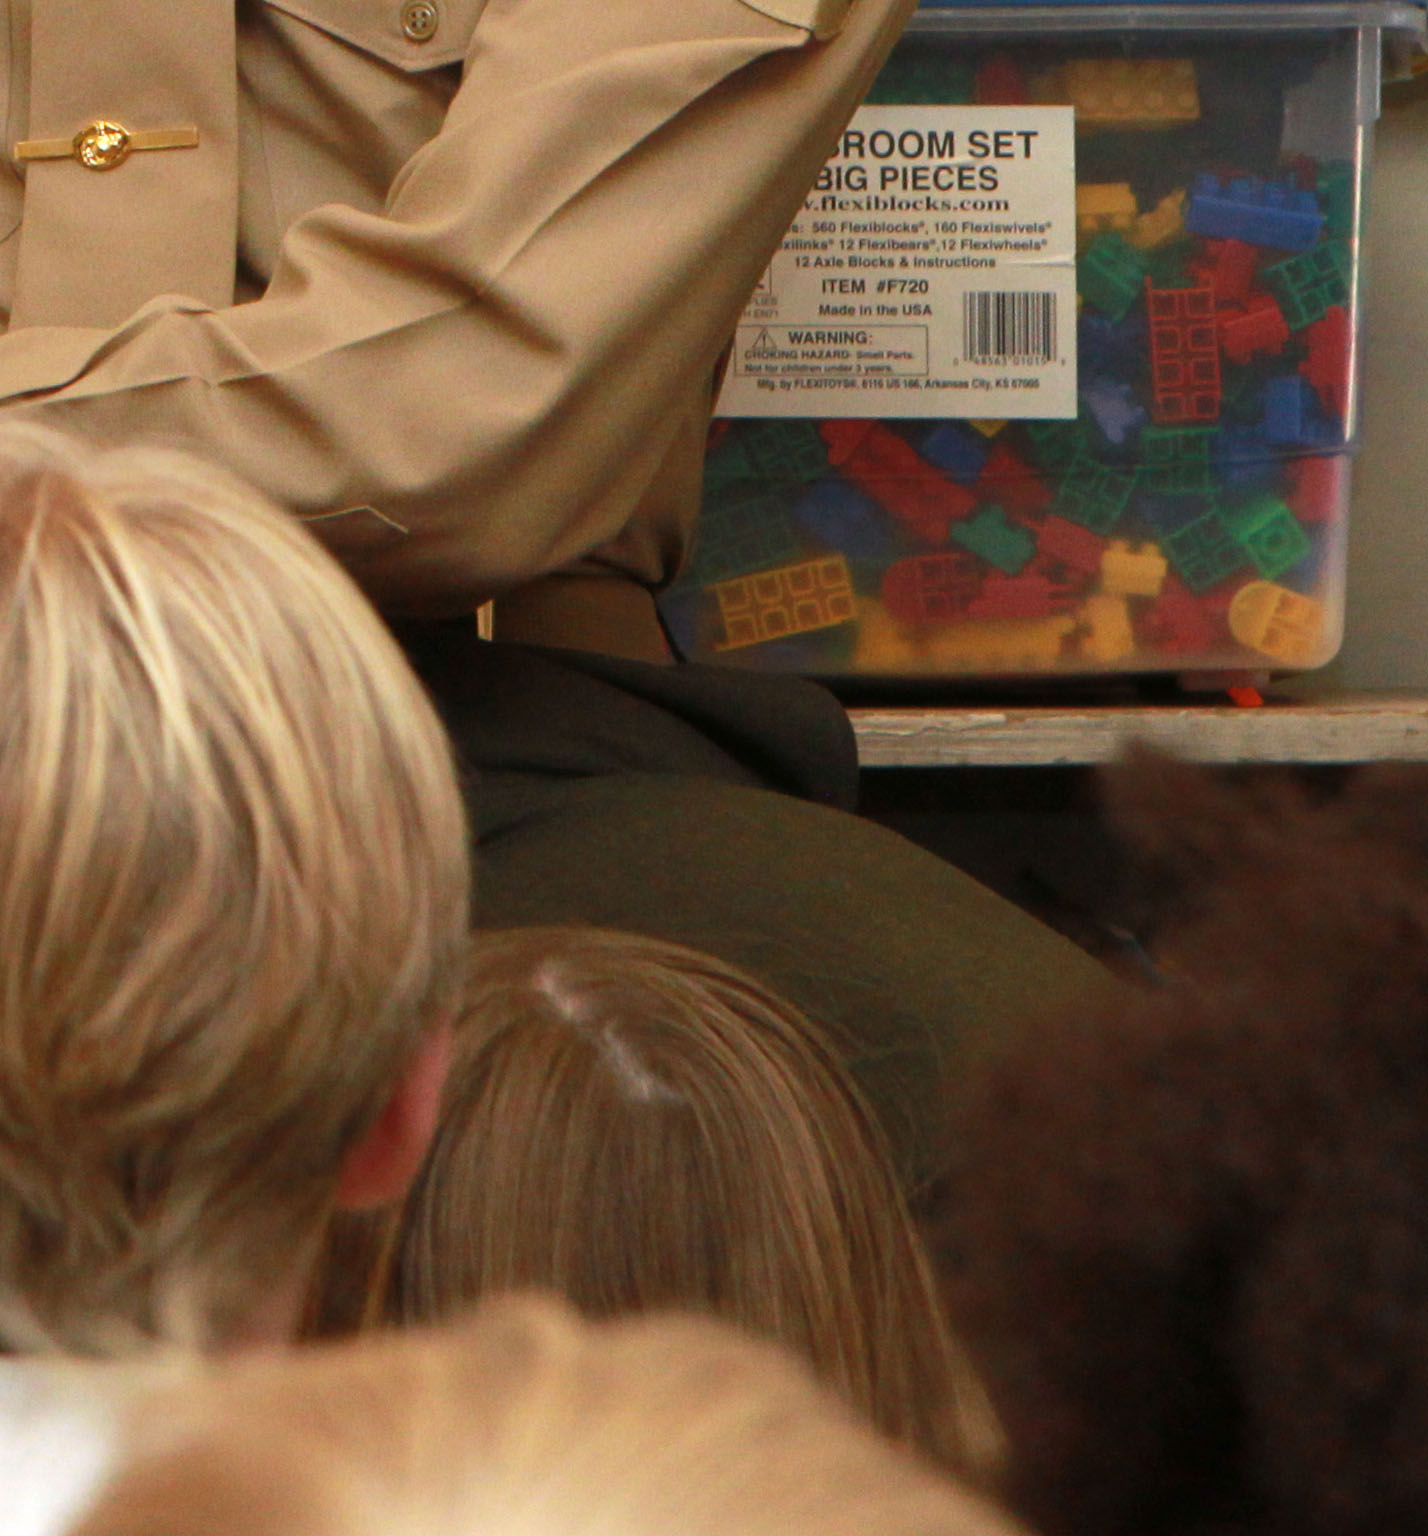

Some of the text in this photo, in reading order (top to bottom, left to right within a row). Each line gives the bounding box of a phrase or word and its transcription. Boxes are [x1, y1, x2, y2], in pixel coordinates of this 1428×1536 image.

[967, 130, 1039, 159] SET
[814, 166, 999, 192] BIG PIECES
[812, 222, 836, 234] 560
[935, 222, 957, 234] 160
[840, 239, 855, 251] 12
[795, 256, 996, 268] 12 Axle Blocks & Instructions
[822, 279, 929, 294] ITEM #F720
[819, 304, 856, 316] Made
[877, 304, 898, 316] the
[902, 304, 933, 316] USA
[788, 330, 873, 344] WARNING:
[744, 350, 797, 360] CHOKING
